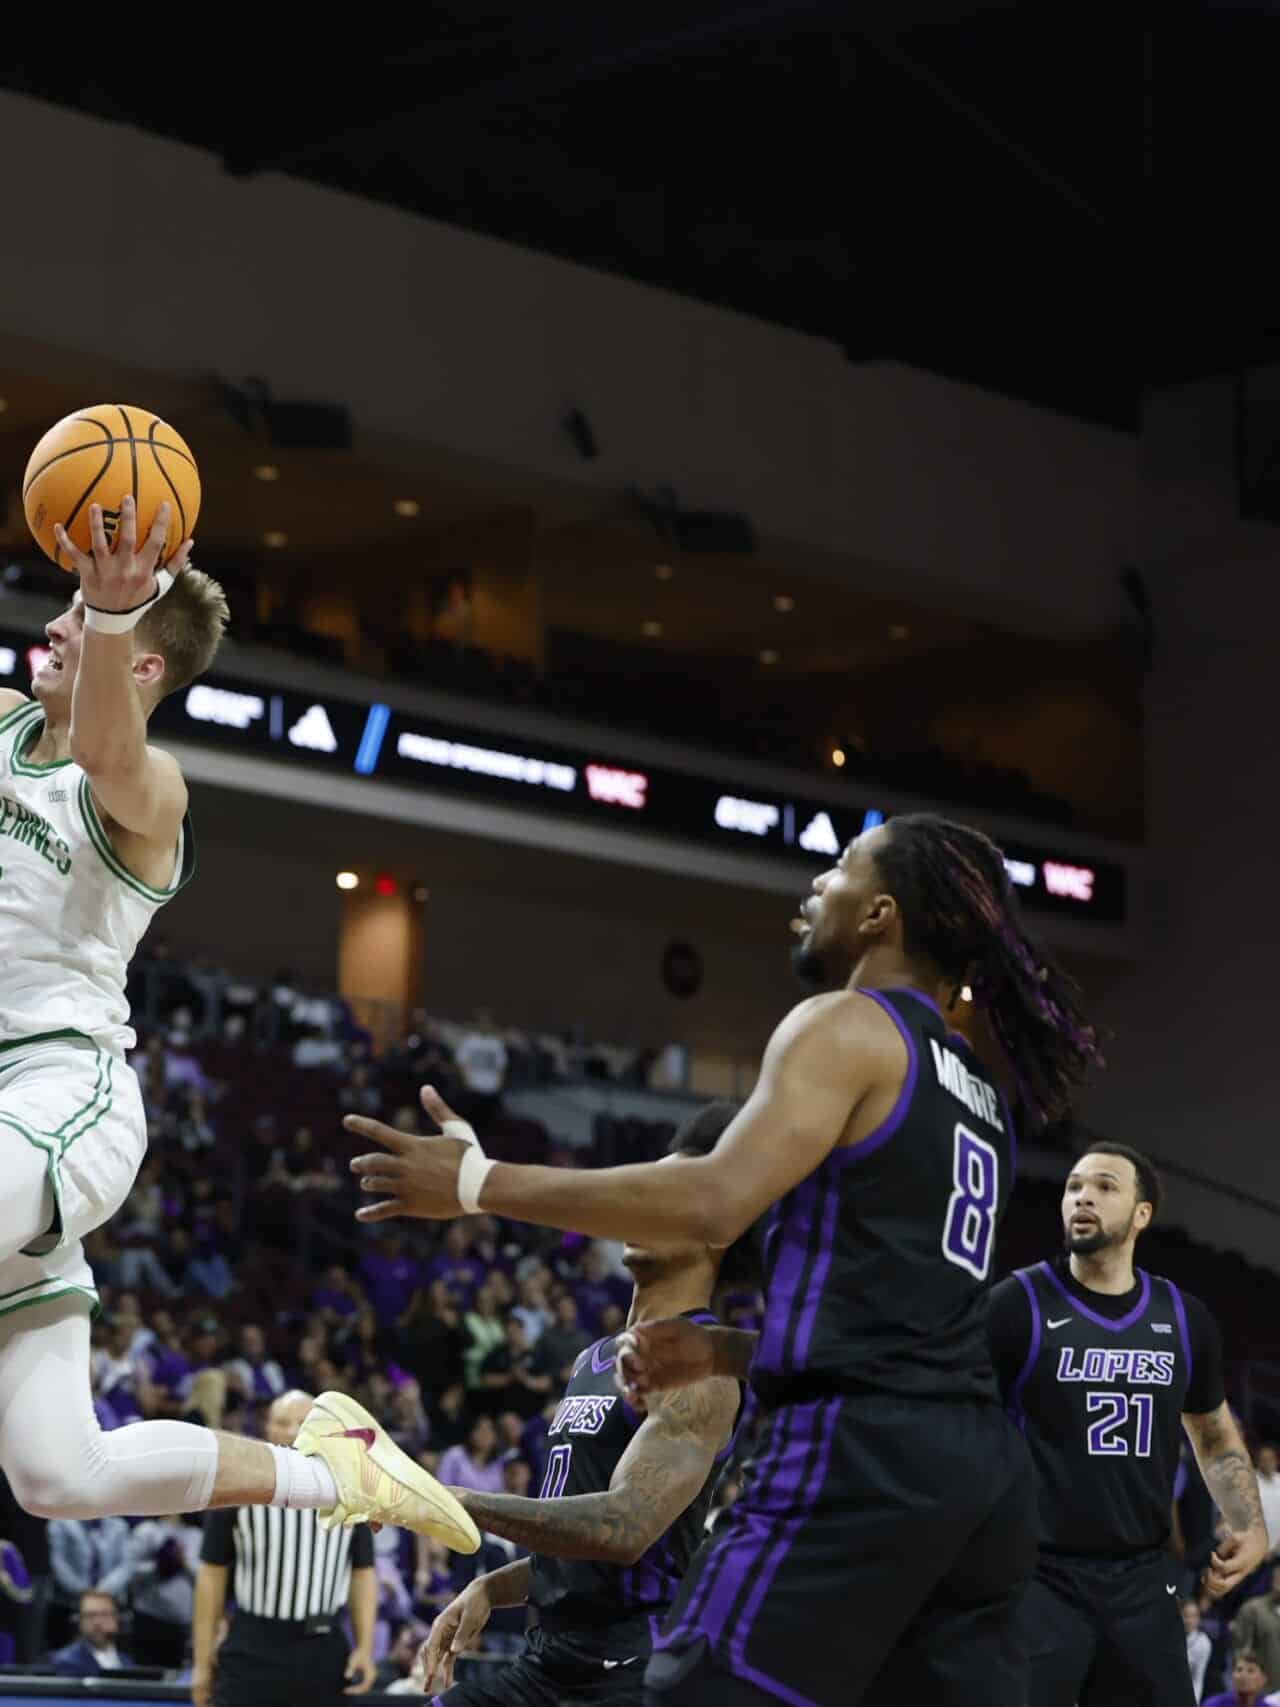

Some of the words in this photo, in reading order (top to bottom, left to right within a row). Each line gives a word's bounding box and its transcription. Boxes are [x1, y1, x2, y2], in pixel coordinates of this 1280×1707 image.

[942, 1121, 999, 1281] 8
[1056, 1346, 1175, 1385] LOPES
[1086, 1392, 1153, 1457] 21
